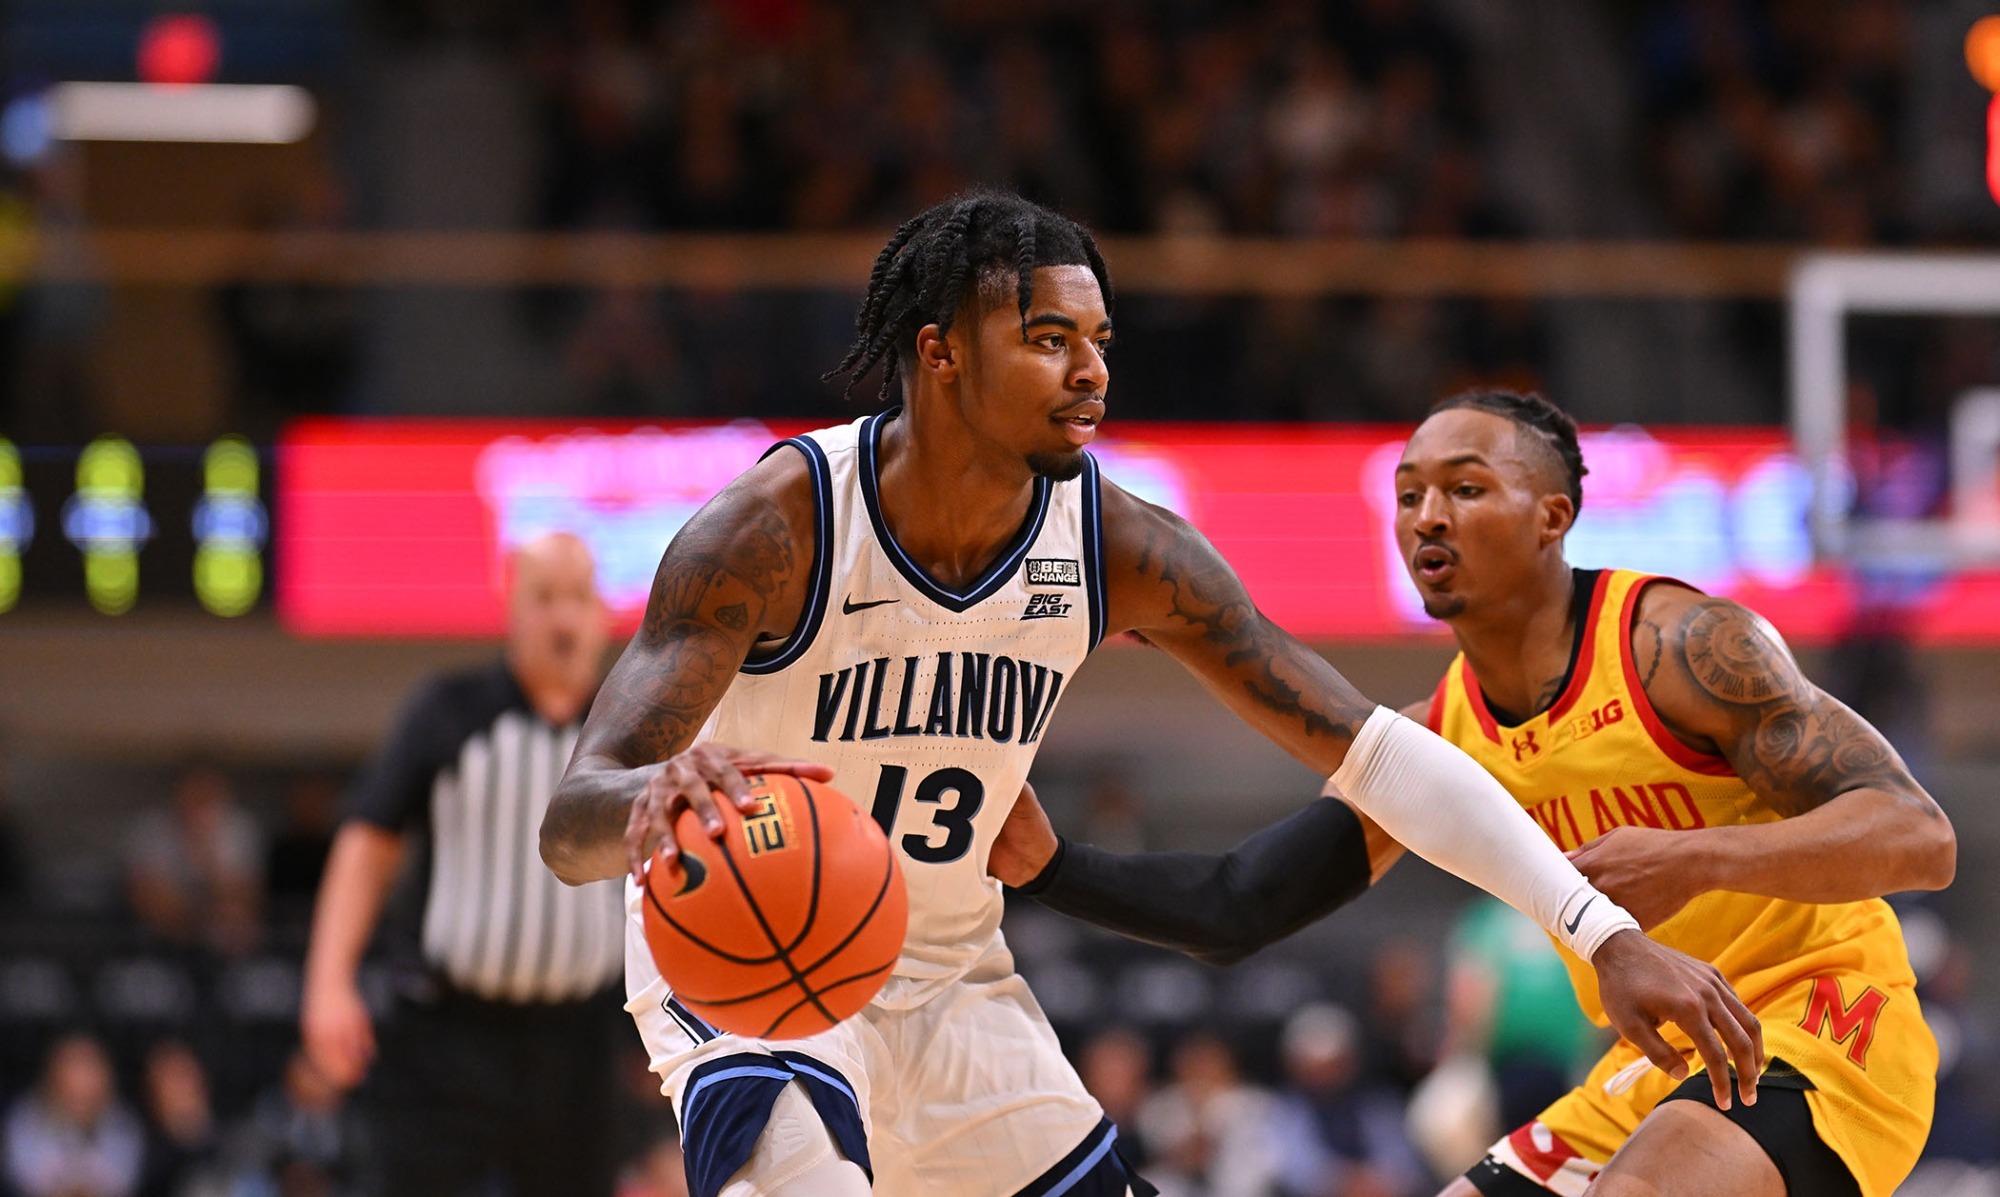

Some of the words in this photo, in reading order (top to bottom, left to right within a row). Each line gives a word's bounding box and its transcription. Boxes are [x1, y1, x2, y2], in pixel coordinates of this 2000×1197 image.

[1029, 572, 1079, 583] CHANGE
[1023, 603, 1072, 615] EAST
[1029, 593, 1064, 605] BIG
[871, 763, 985, 864] 13
[1525, 781, 1707, 852] YLAND
[1797, 975, 1890, 1071] M
